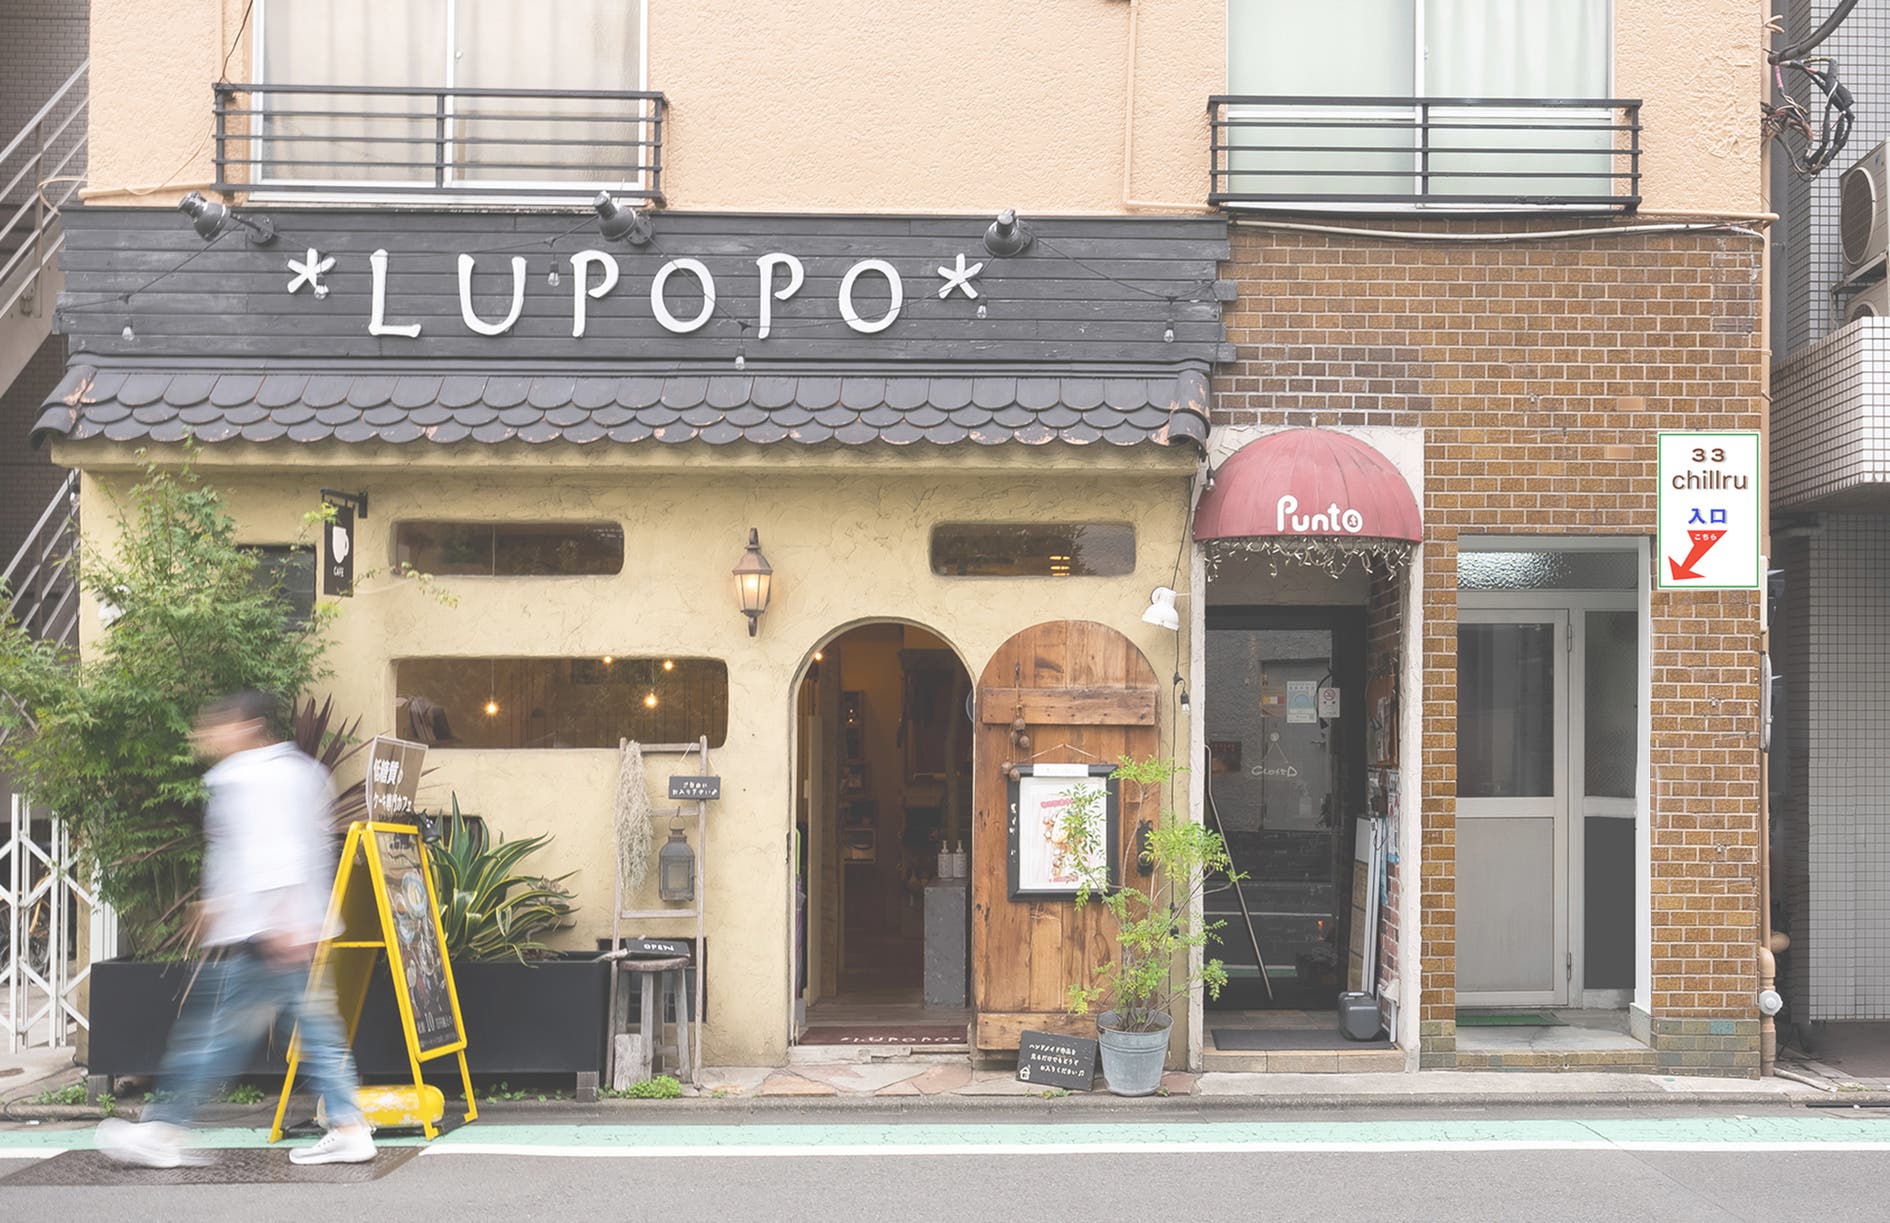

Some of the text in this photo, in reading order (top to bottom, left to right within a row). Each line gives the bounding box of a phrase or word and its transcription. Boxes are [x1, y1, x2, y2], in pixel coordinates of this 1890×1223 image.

[367, 248, 905, 341] LUPOPO
[1672, 470, 1748, 490] chillru
[1277, 494, 1363, 533] Punto
[1687, 507, 1727, 525] 入口
[1694, 533, 1718, 541] こちら
[643, 943, 675, 952] OPEN
